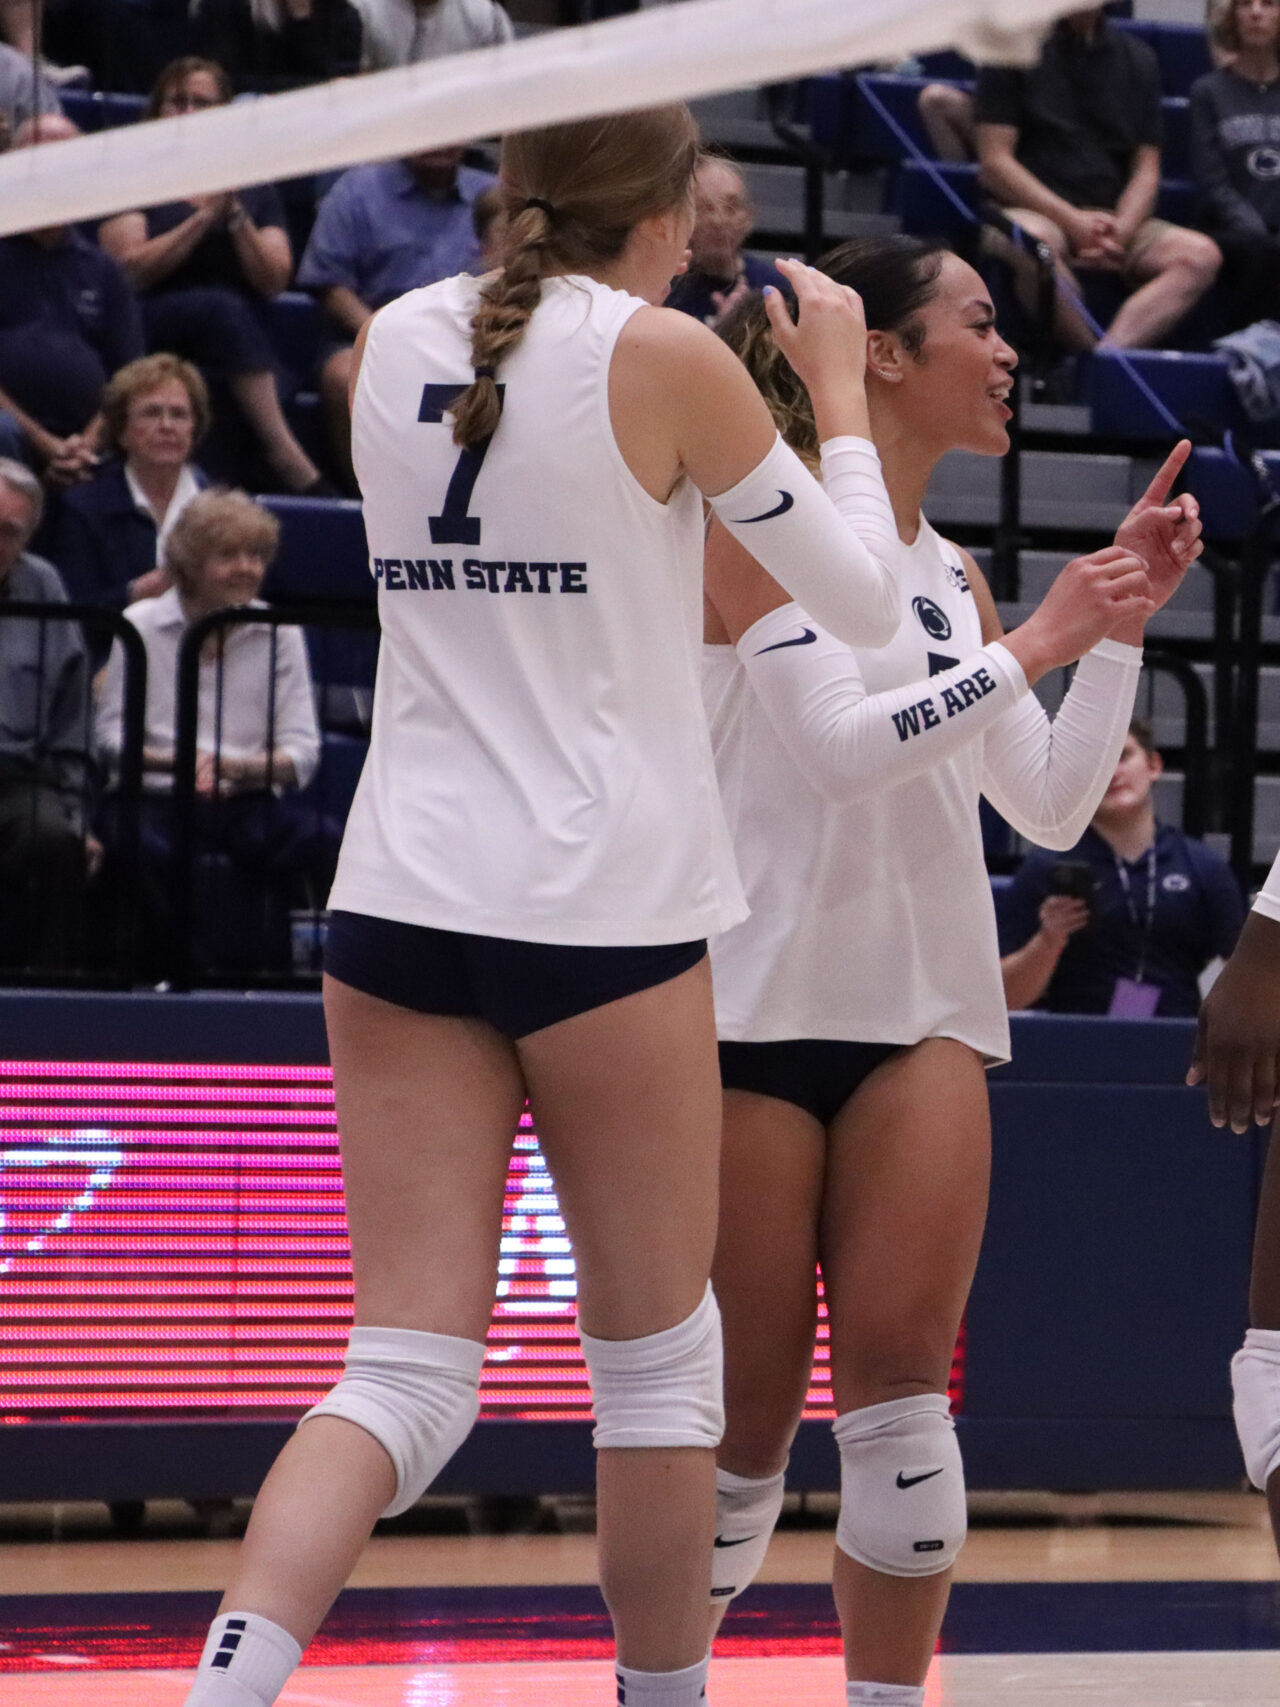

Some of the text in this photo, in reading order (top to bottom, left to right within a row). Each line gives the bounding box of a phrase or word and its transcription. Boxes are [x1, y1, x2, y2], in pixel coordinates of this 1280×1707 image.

[418, 383, 506, 546] 7
[373, 557, 588, 594] PENN STATE
[891, 667, 997, 742] WE ARE
